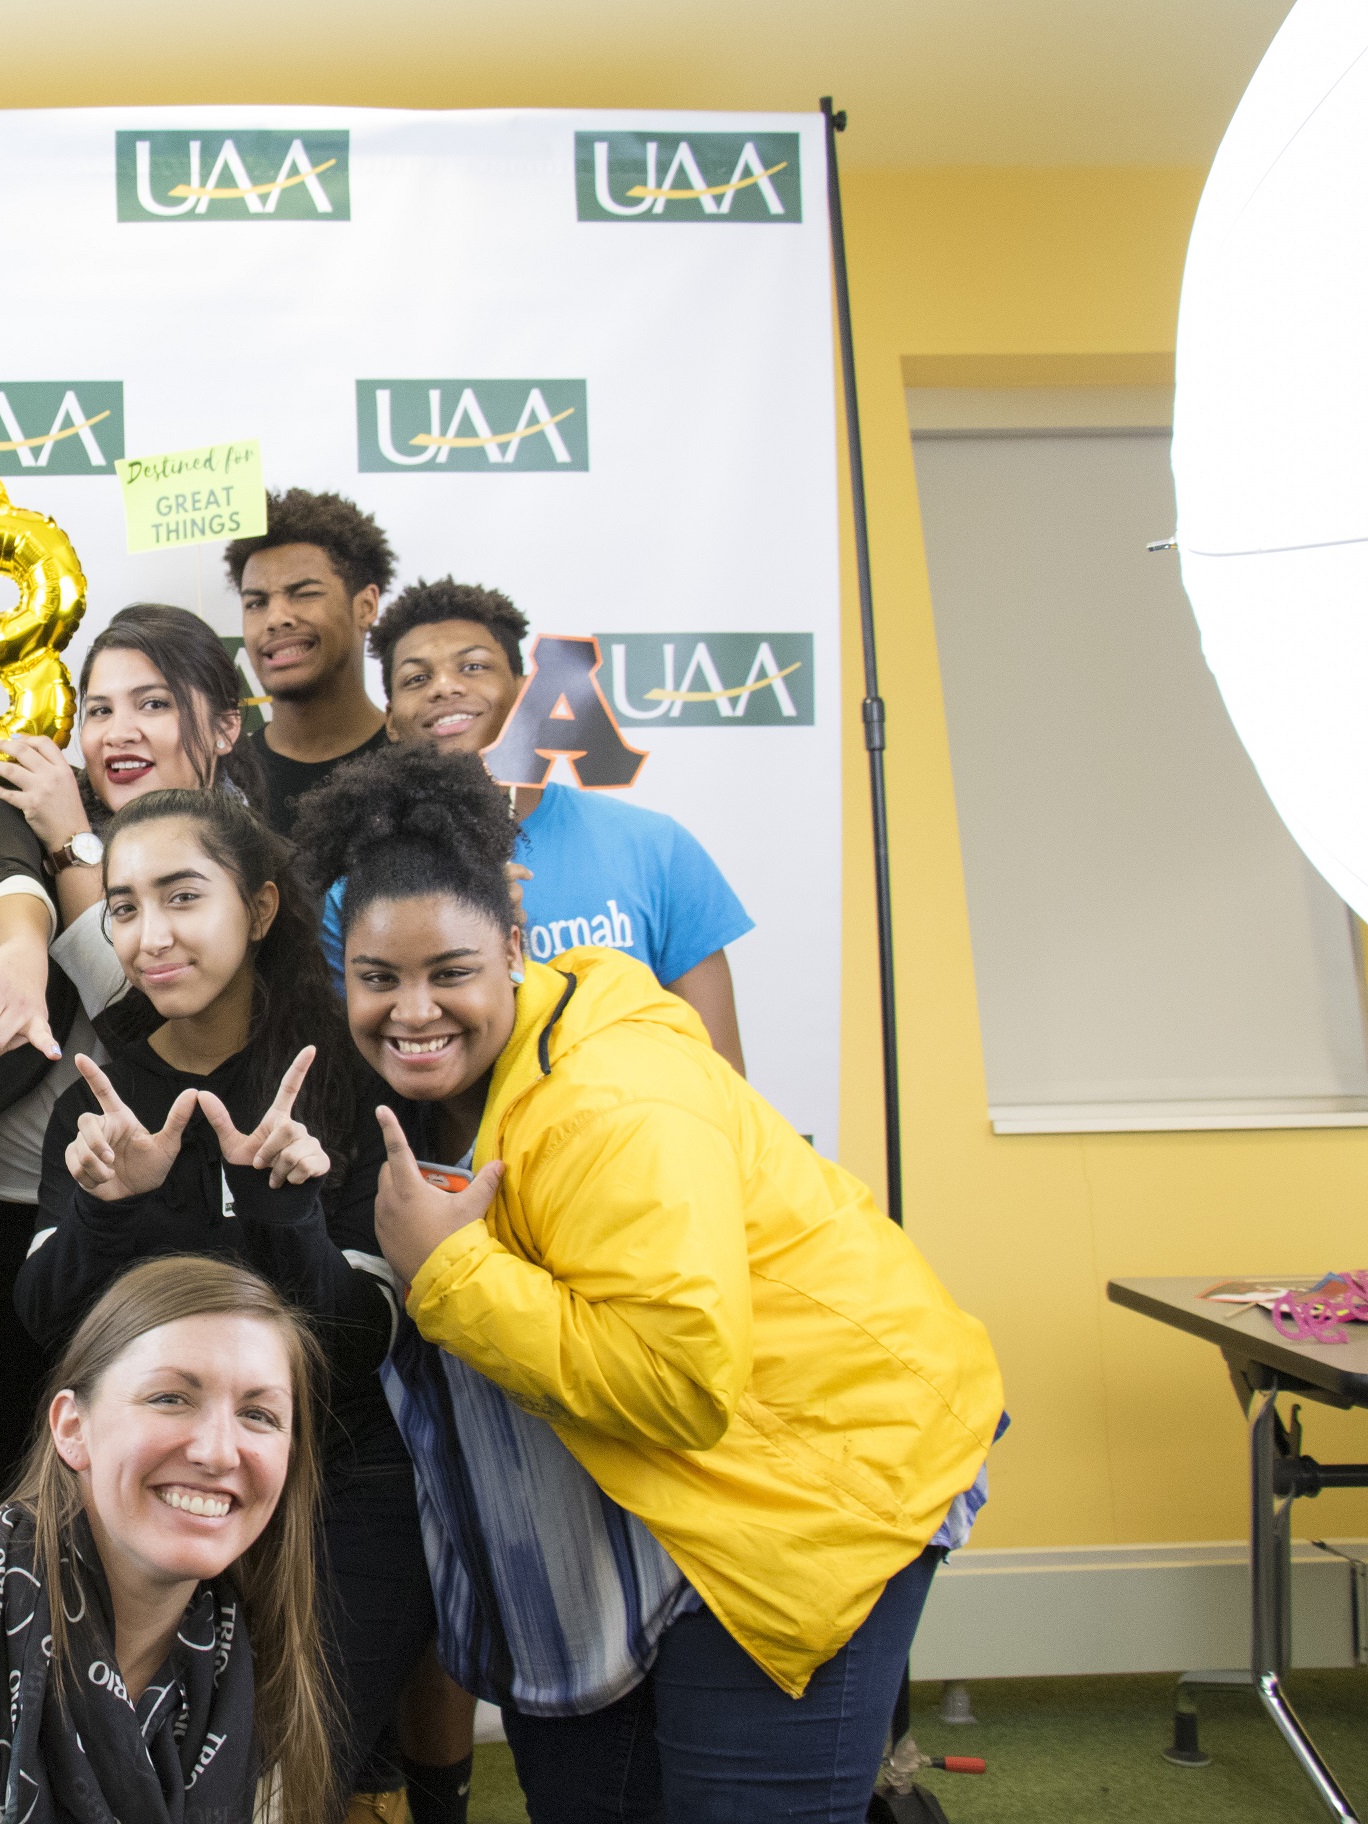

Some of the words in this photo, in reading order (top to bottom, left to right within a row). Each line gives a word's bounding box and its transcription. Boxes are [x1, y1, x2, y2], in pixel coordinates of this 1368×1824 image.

[136, 139, 334, 216] UAA
[594, 141, 786, 216] UAA
[376, 388, 573, 465] UAA
[127, 448, 215, 484] Destined
[224, 446, 254, 474] for
[151, 512, 241, 543] THINGS
[156, 486, 234, 516] GREAT
[611, 642, 800, 720] UAA
[523, 900, 634, 958] ornah
